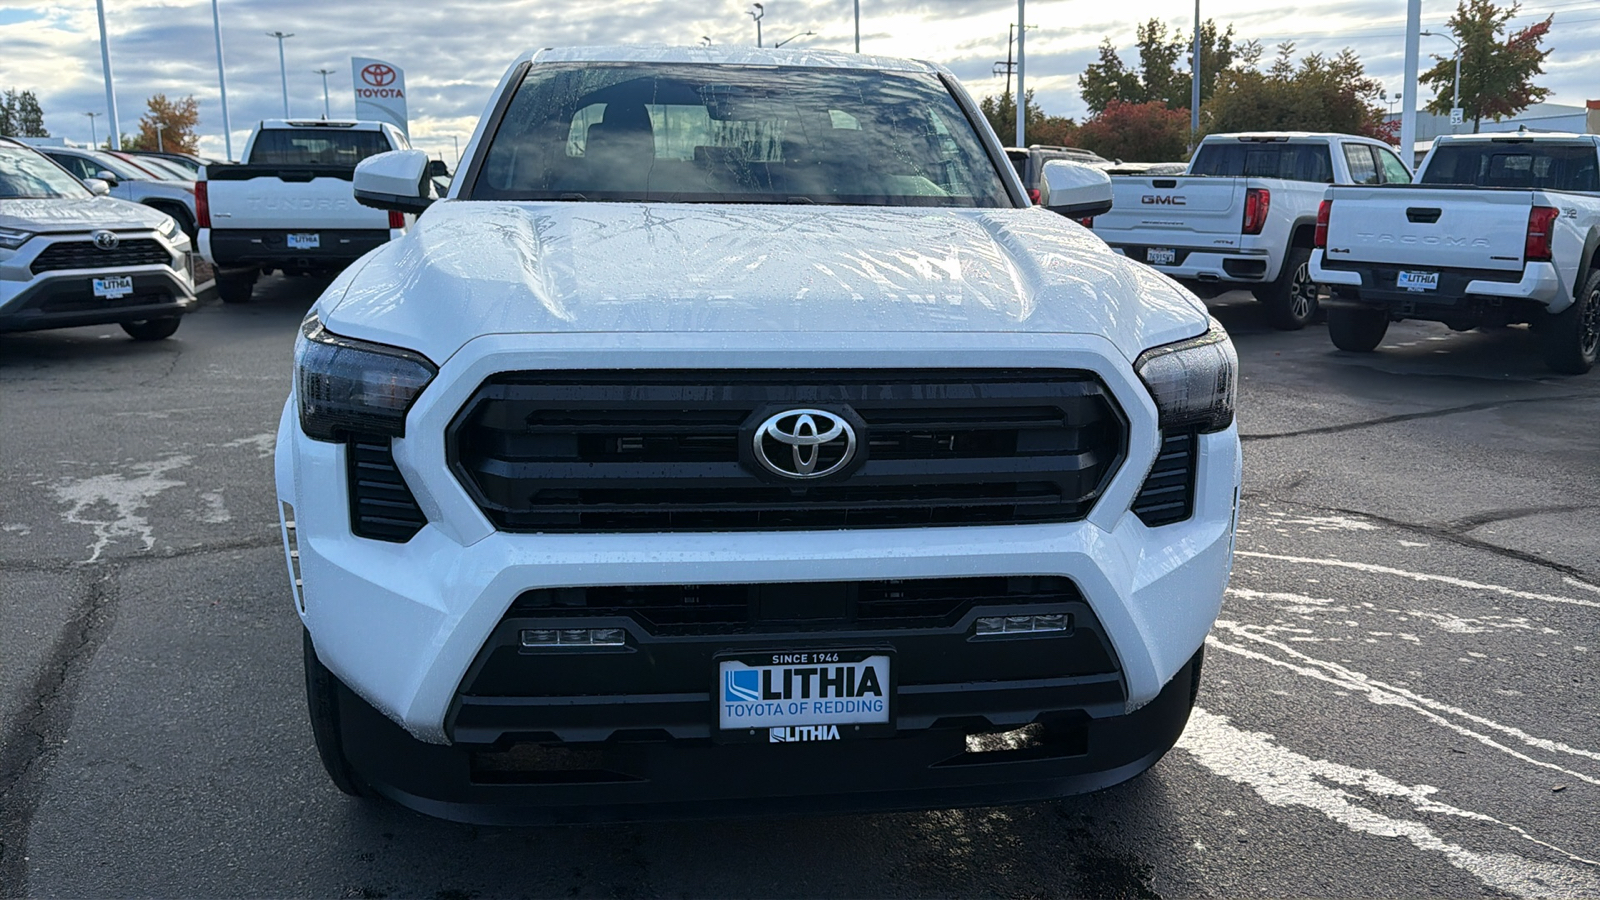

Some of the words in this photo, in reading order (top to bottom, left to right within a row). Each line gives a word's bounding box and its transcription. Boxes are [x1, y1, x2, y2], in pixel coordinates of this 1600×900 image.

[356, 88, 404, 98] TOYOTA
[1451, 116, 1462, 124] 35
[247, 197, 350, 211] TUNDRA
[1141, 195, 1187, 206] GMC
[1356, 232, 1491, 248] TACOMA
[103, 279, 131, 290] LITHIA
[1407, 274, 1436, 284] LITHIA
[772, 655, 808, 664] SINCE
[812, 653, 839, 663] 1946
[762, 666, 883, 700] LITHIA
[725, 703, 784, 718] TOYOTA
[788, 702, 809, 715] OF
[813, 700, 884, 714] REDDING
[785, 725, 841, 742] LITHIA
